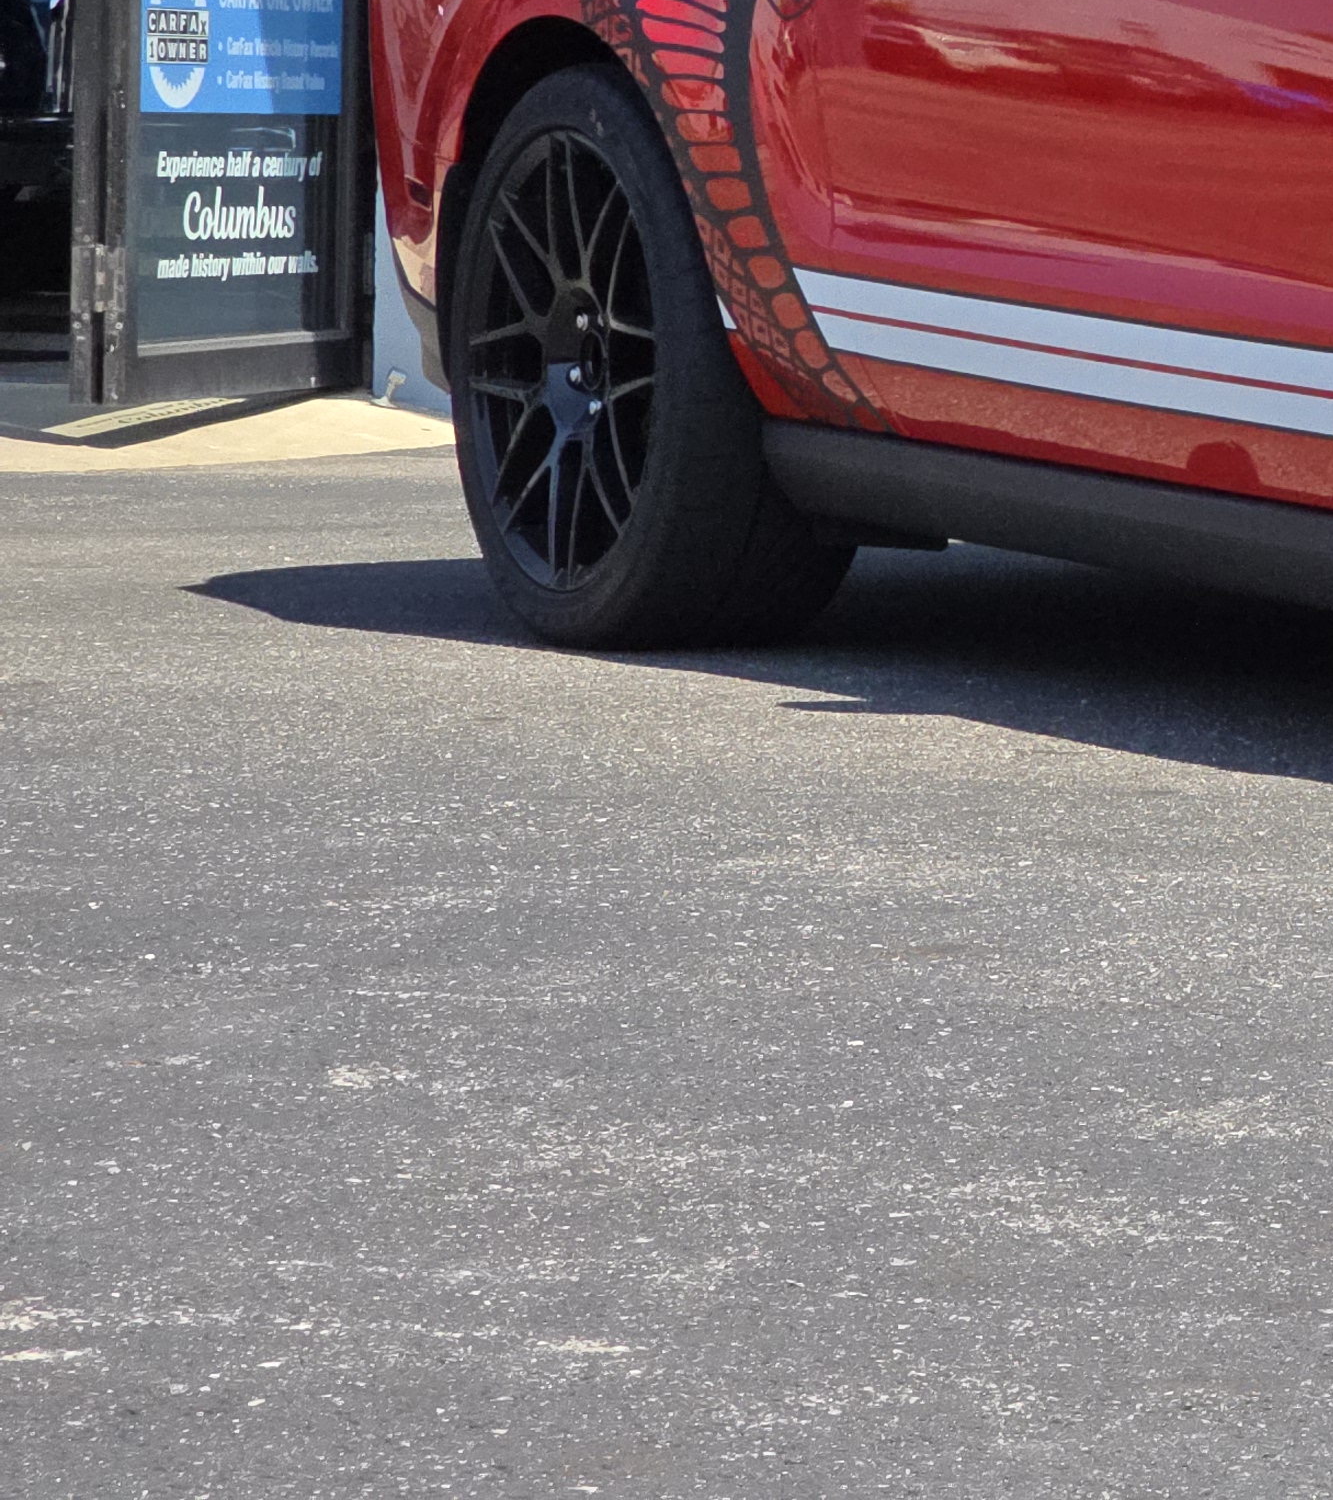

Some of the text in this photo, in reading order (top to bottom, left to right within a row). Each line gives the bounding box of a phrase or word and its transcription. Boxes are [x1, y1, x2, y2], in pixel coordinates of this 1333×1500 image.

[148, 12, 207, 36] CARFAX
[157, 151, 323, 184] Experience half a century of
[183, 186, 297, 241] Columbus
[157, 254, 190, 279] made
[191, 253, 231, 282] history
[231, 252, 266, 277] within
[267, 256, 287, 275] our
